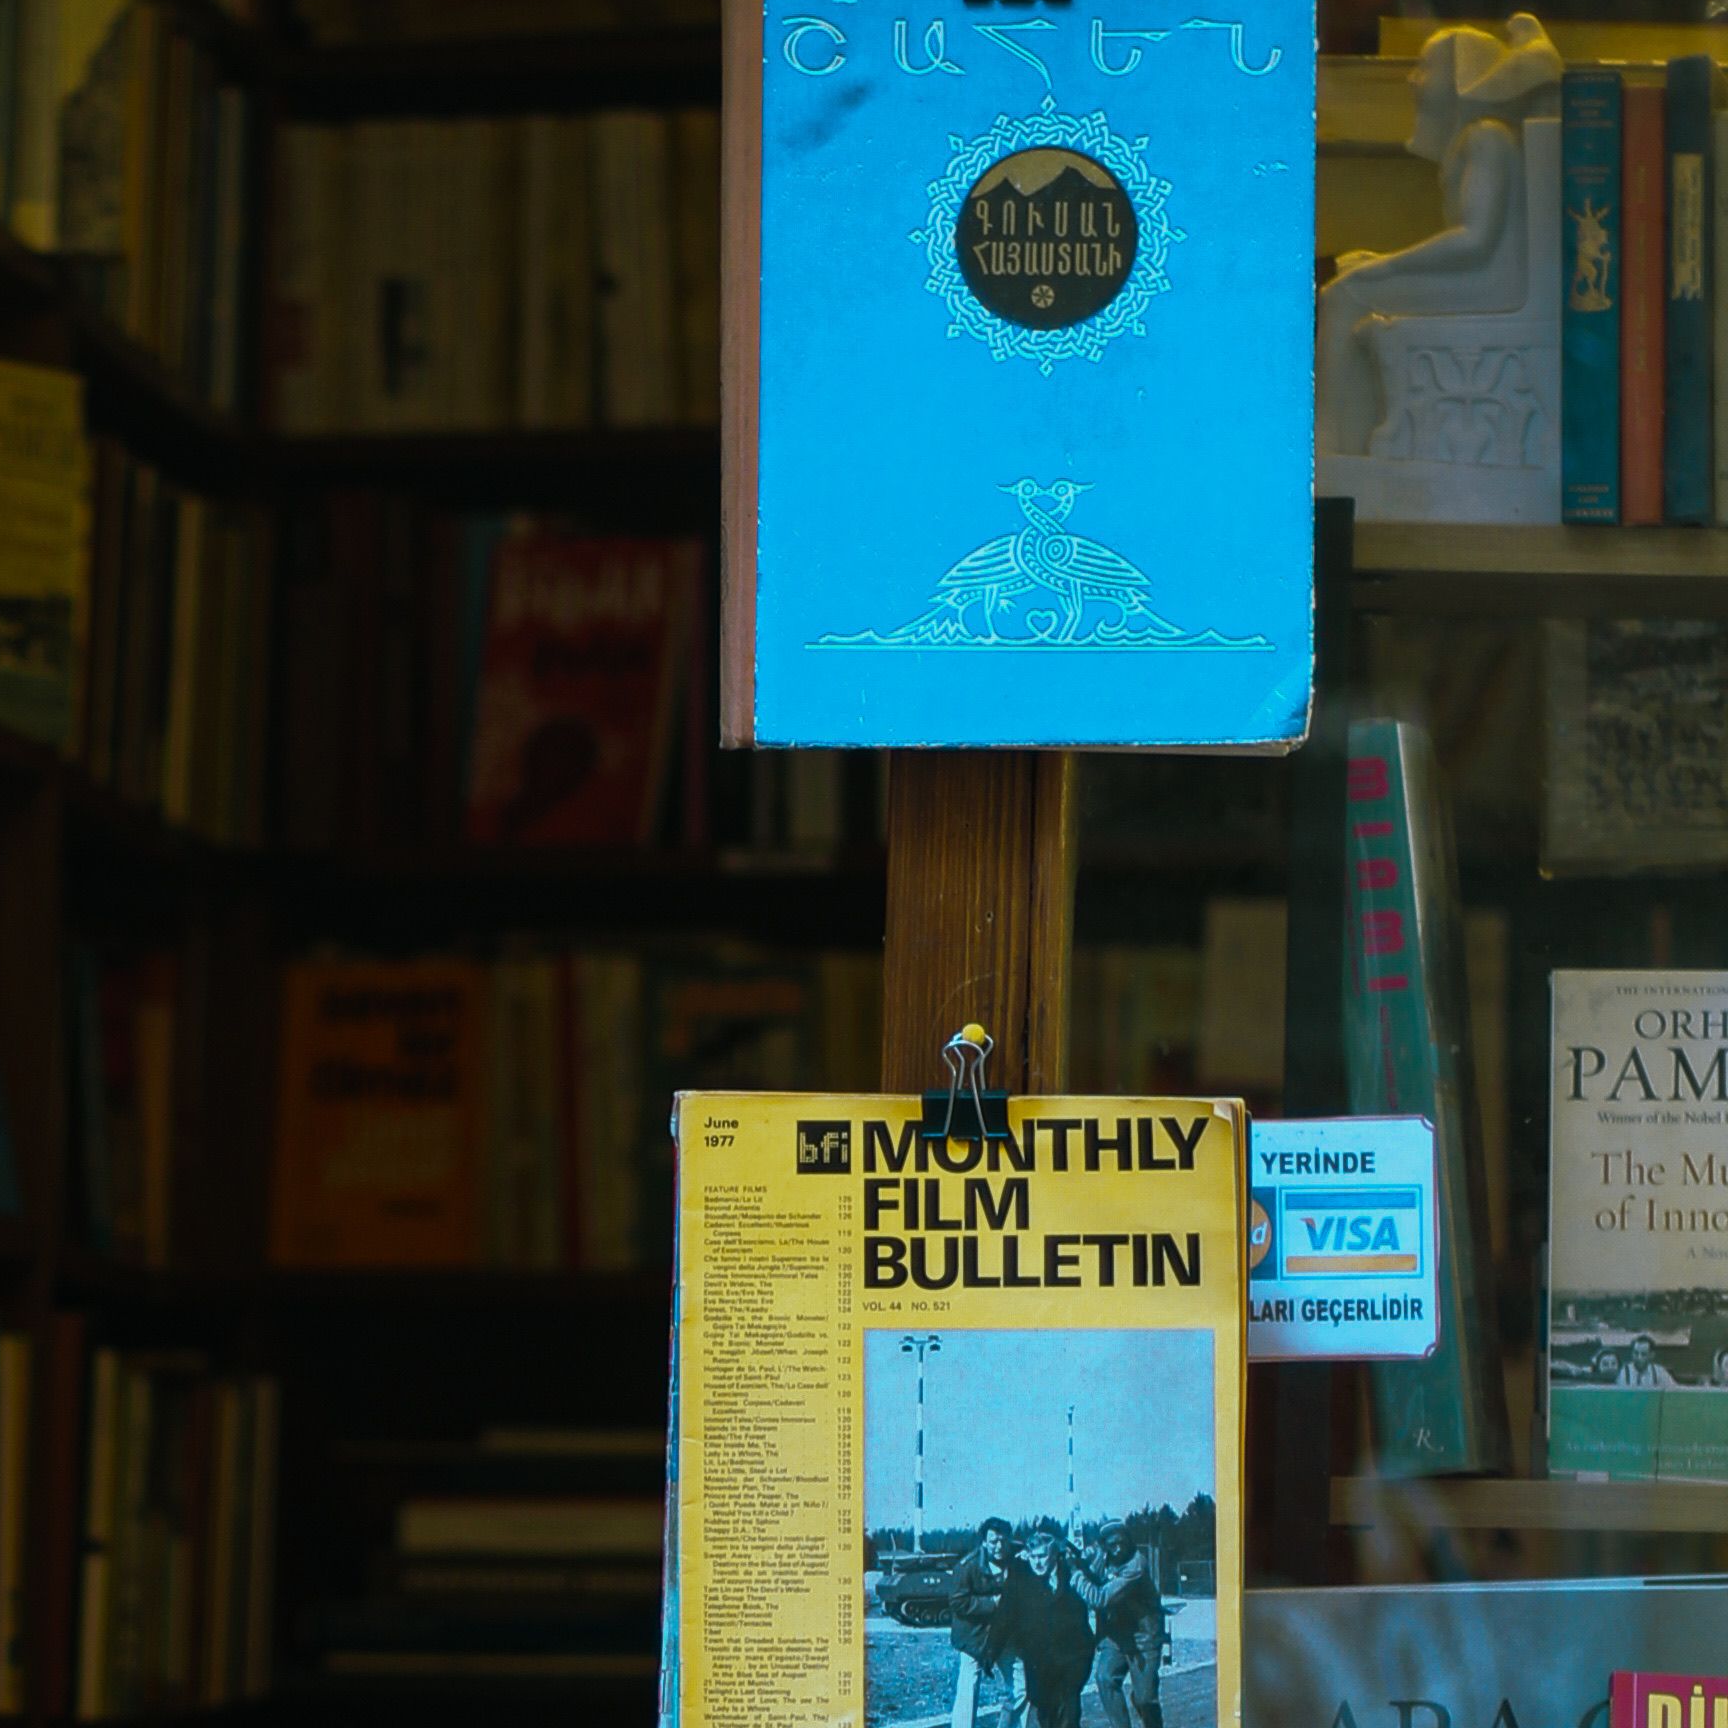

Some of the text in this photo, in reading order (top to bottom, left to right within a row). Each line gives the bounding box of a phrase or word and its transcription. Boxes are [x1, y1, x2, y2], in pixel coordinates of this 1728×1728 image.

[780, 14, 1284, 94] ՇԱՀԵՆ
[975, 199, 1121, 238] ԳՈՒՍԱՆ
[972, 241, 1122, 276] ՀԱՅԱՍՏԱՆԻ
[1566, 1046, 1728, 1102] PAM
[703, 1116, 739, 1130] June
[703, 1135, 735, 1148] 1977
[798, 1130, 850, 1164] bfi
[862, 1117, 1210, 1174] MONTHLY
[1259, 1147, 1377, 1176] YERİNDE
[1590, 1149, 1666, 1187] The
[704, 1186, 768, 1194] FEATURE FILMS
[863, 1178, 1029, 1230] FILM
[1594, 1194, 1636, 1233] of
[1299, 1215, 1401, 1252] VISA
[863, 1233, 1201, 1290] BULLETIN
[862, 1301, 952, 1312] VOL. 44 NO. 521
[1249, 1291, 1425, 1328] LARI GEÇERLİDİR
